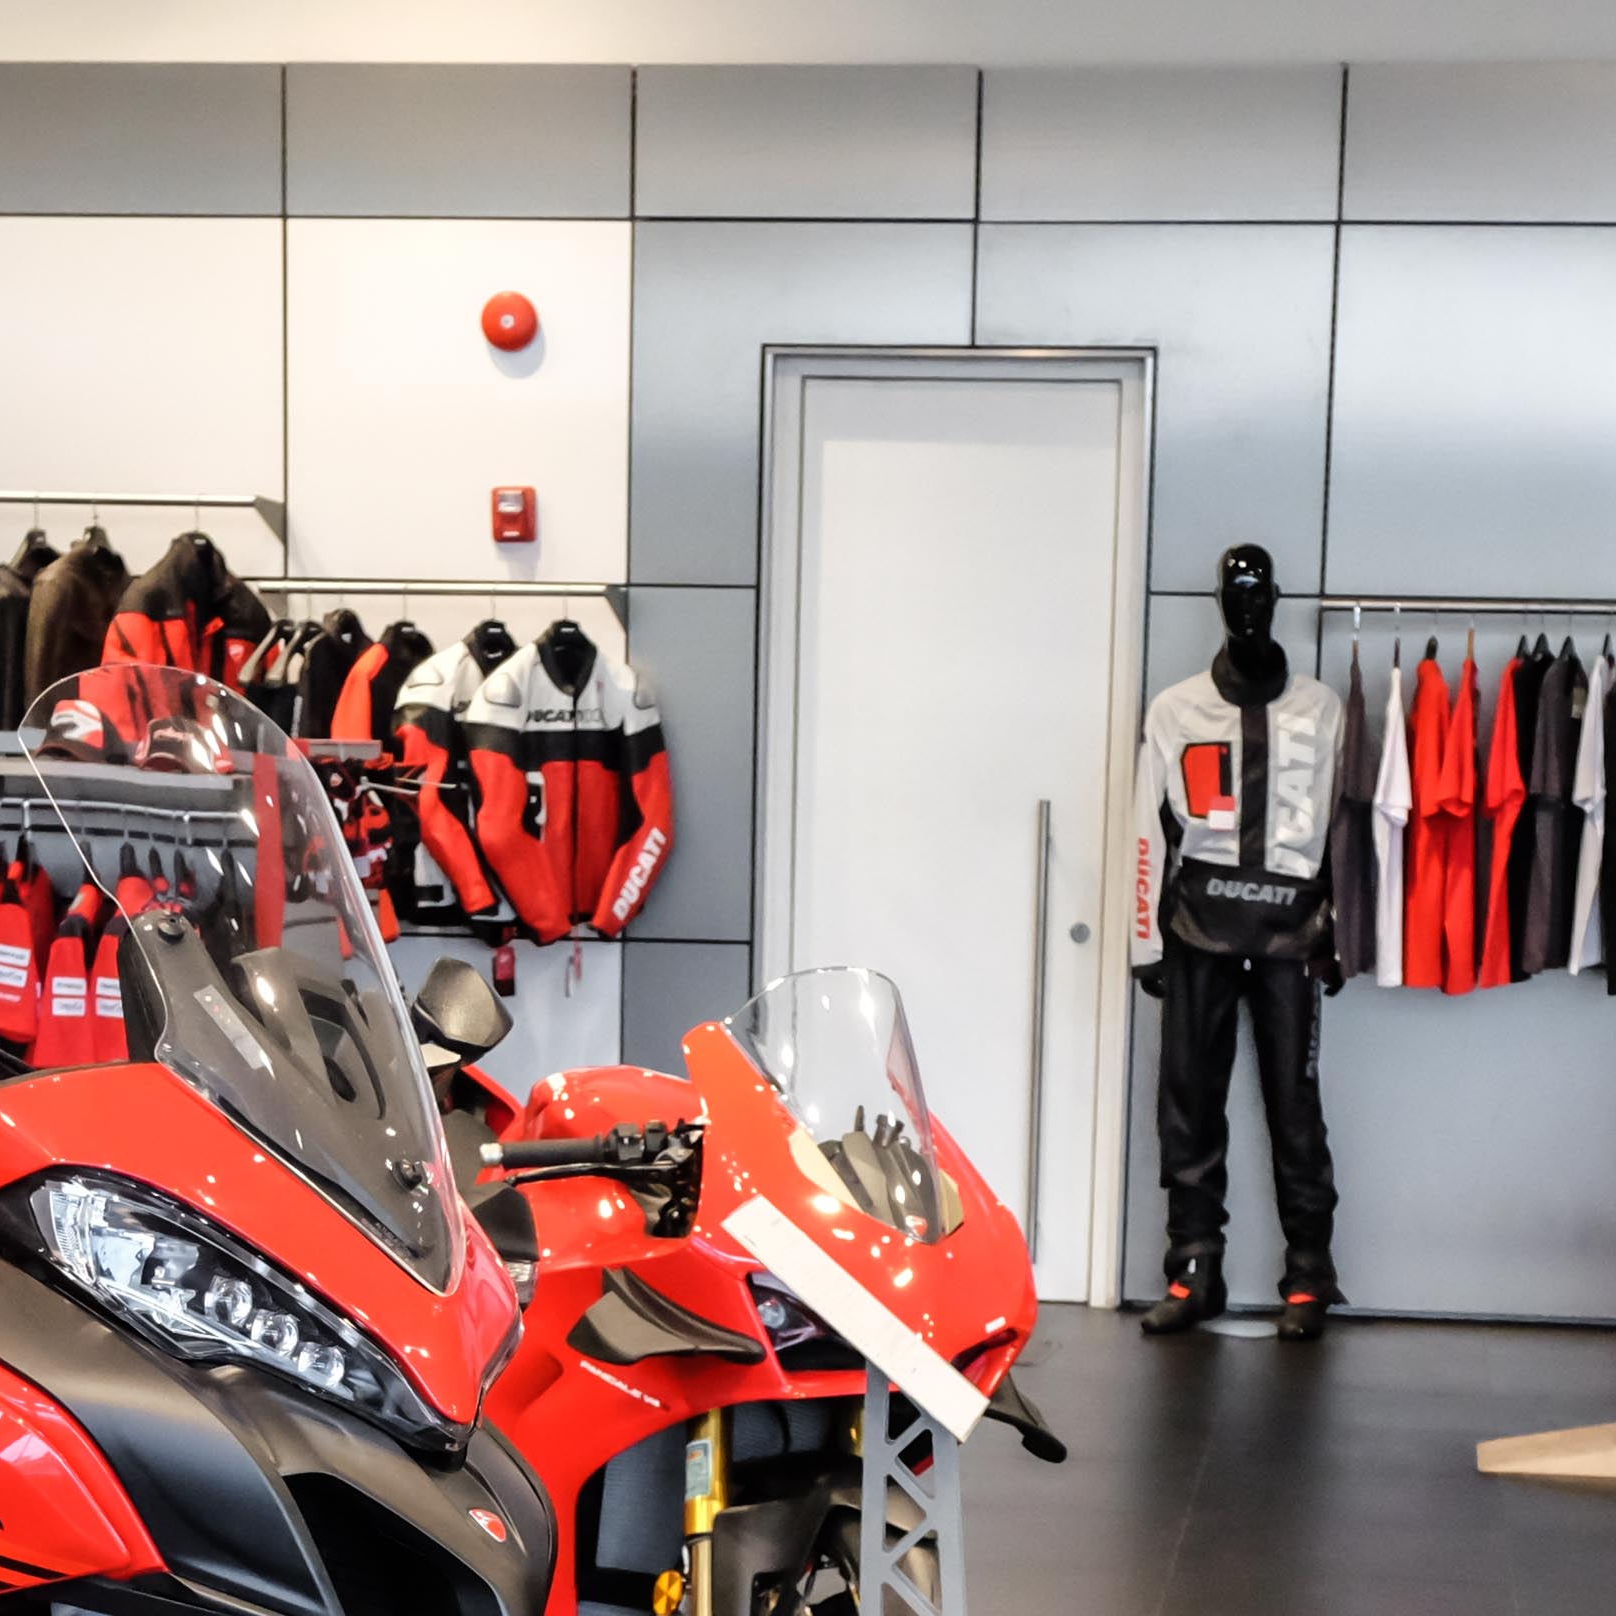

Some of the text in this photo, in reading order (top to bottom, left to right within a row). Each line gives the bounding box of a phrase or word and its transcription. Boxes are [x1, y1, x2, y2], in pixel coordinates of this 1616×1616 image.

[612, 827, 667, 921] DUCATI
[1136, 837, 1152, 941] DUCATI
[1206, 877, 1297, 905] DUCATI
